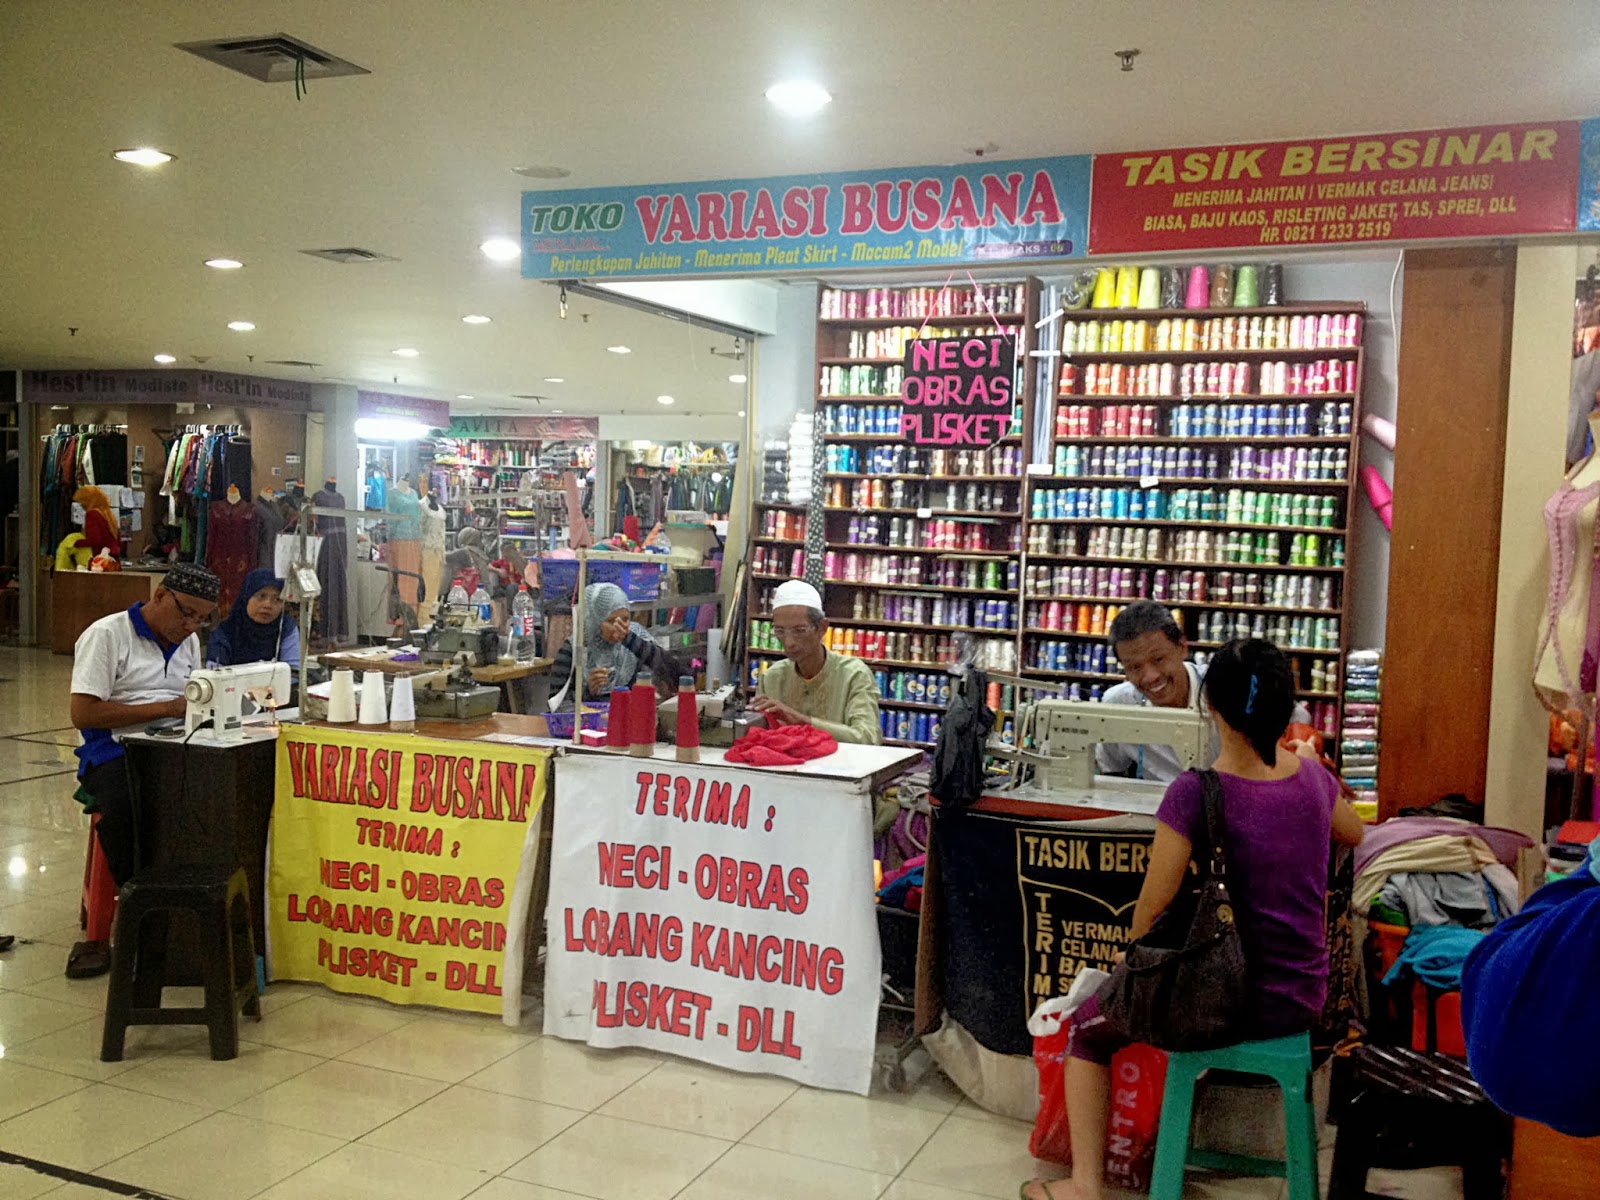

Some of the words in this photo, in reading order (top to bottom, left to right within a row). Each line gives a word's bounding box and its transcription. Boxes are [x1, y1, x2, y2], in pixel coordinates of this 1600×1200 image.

[1122, 149, 1262, 186] TASIK
[1280, 128, 1558, 177] BERSINAR
[532, 203, 624, 234] TOKO
[635, 185, 830, 244] VARIASI
[840, 169, 1065, 234] BUSANA
[1143, 215, 1187, 233] BIASA,
[1190, 212, 1226, 229] BAJU
[1272, 204, 1347, 224] RISLETING
[1489, 195, 1517, 214] DLL
[1172, 189, 1243, 208] MENERIMA
[1247, 186, 1306, 203] JAHITAN
[1317, 181, 1376, 200] VERMAK
[1380, 176, 1437, 196] CELANA
[1283, 223, 1316, 241] 0821
[1321, 222, 1354, 240] 1233
[1357, 220, 1391, 238] 2519
[550, 253, 632, 275] Perlengkapan
[636, 251, 681, 270] Jahitan
[694, 248, 760, 268] Menerima
[765, 246, 799, 265] Pleat
[803, 241, 838, 263] Skirt
[851, 241, 912, 261] Macam2
[916, 238, 964, 258] Model
[912, 339, 1001, 372] NECI
[901, 375, 1011, 407] OBRAS
[900, 413, 1012, 445] PLISKET
[287, 741, 403, 809] VARIASI
[635, 771, 751, 829] TERIMA
[357, 818, 443, 857] TERIMA
[1025, 836, 1091, 871] TASIK
[319, 857, 380, 892] NECI
[401, 870, 505, 908] OBRAS
[598, 842, 671, 890] NECI
[695, 854, 809, 915] OBRAS
[288, 894, 394, 936] LOBANG
[397, 911, 508, 952] KANCIN
[564, 907, 683, 962] LOBANG
[691, 922, 844, 995] KANCING
[1033, 892, 1055, 1010] TERIM
[445, 960, 503, 996] DLL
[737, 1004, 802, 1060] DLL
[1106, 1061, 1141, 1187] ENTRO
